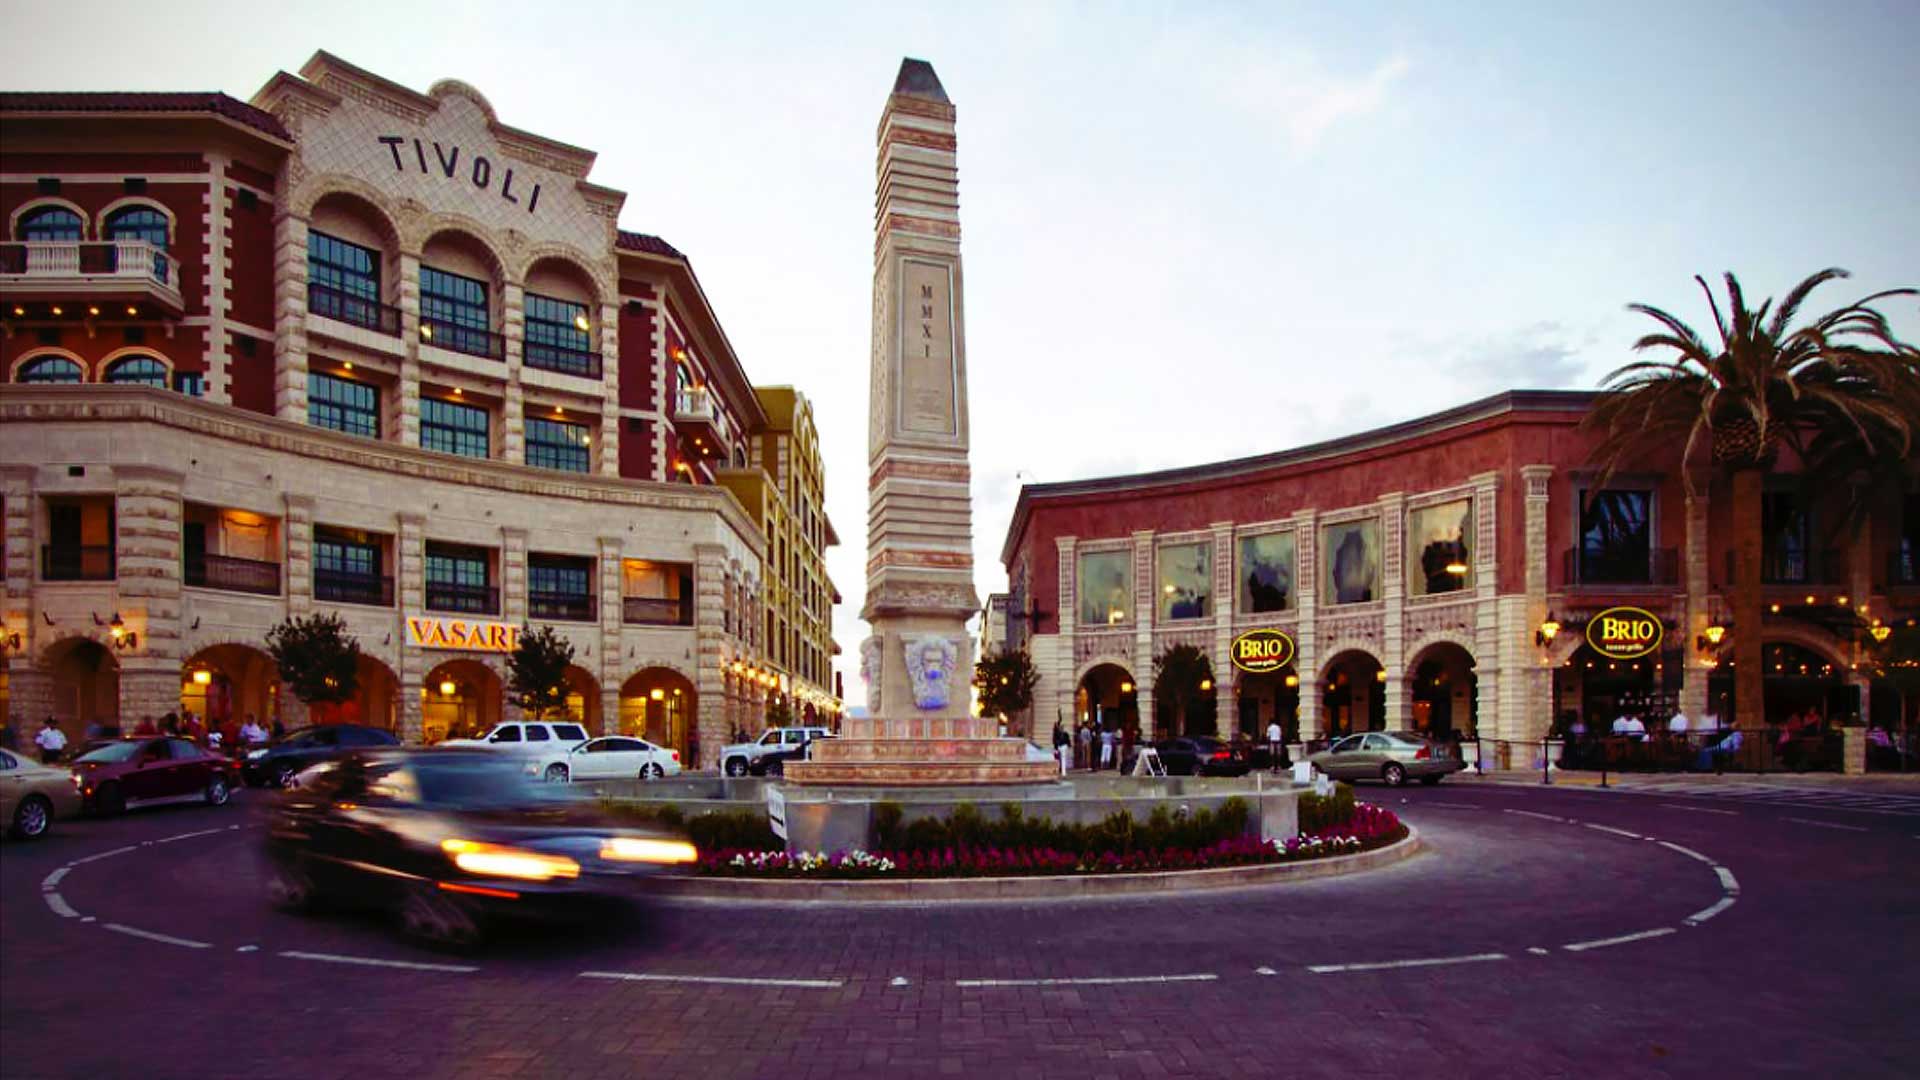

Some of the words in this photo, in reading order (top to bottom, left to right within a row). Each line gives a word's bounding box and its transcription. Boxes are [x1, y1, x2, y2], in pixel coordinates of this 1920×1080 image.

[378, 136, 541, 213] TIVOLI
[1602, 617, 1654, 640] BRIO
[1240, 639, 1282, 658] BRIO
